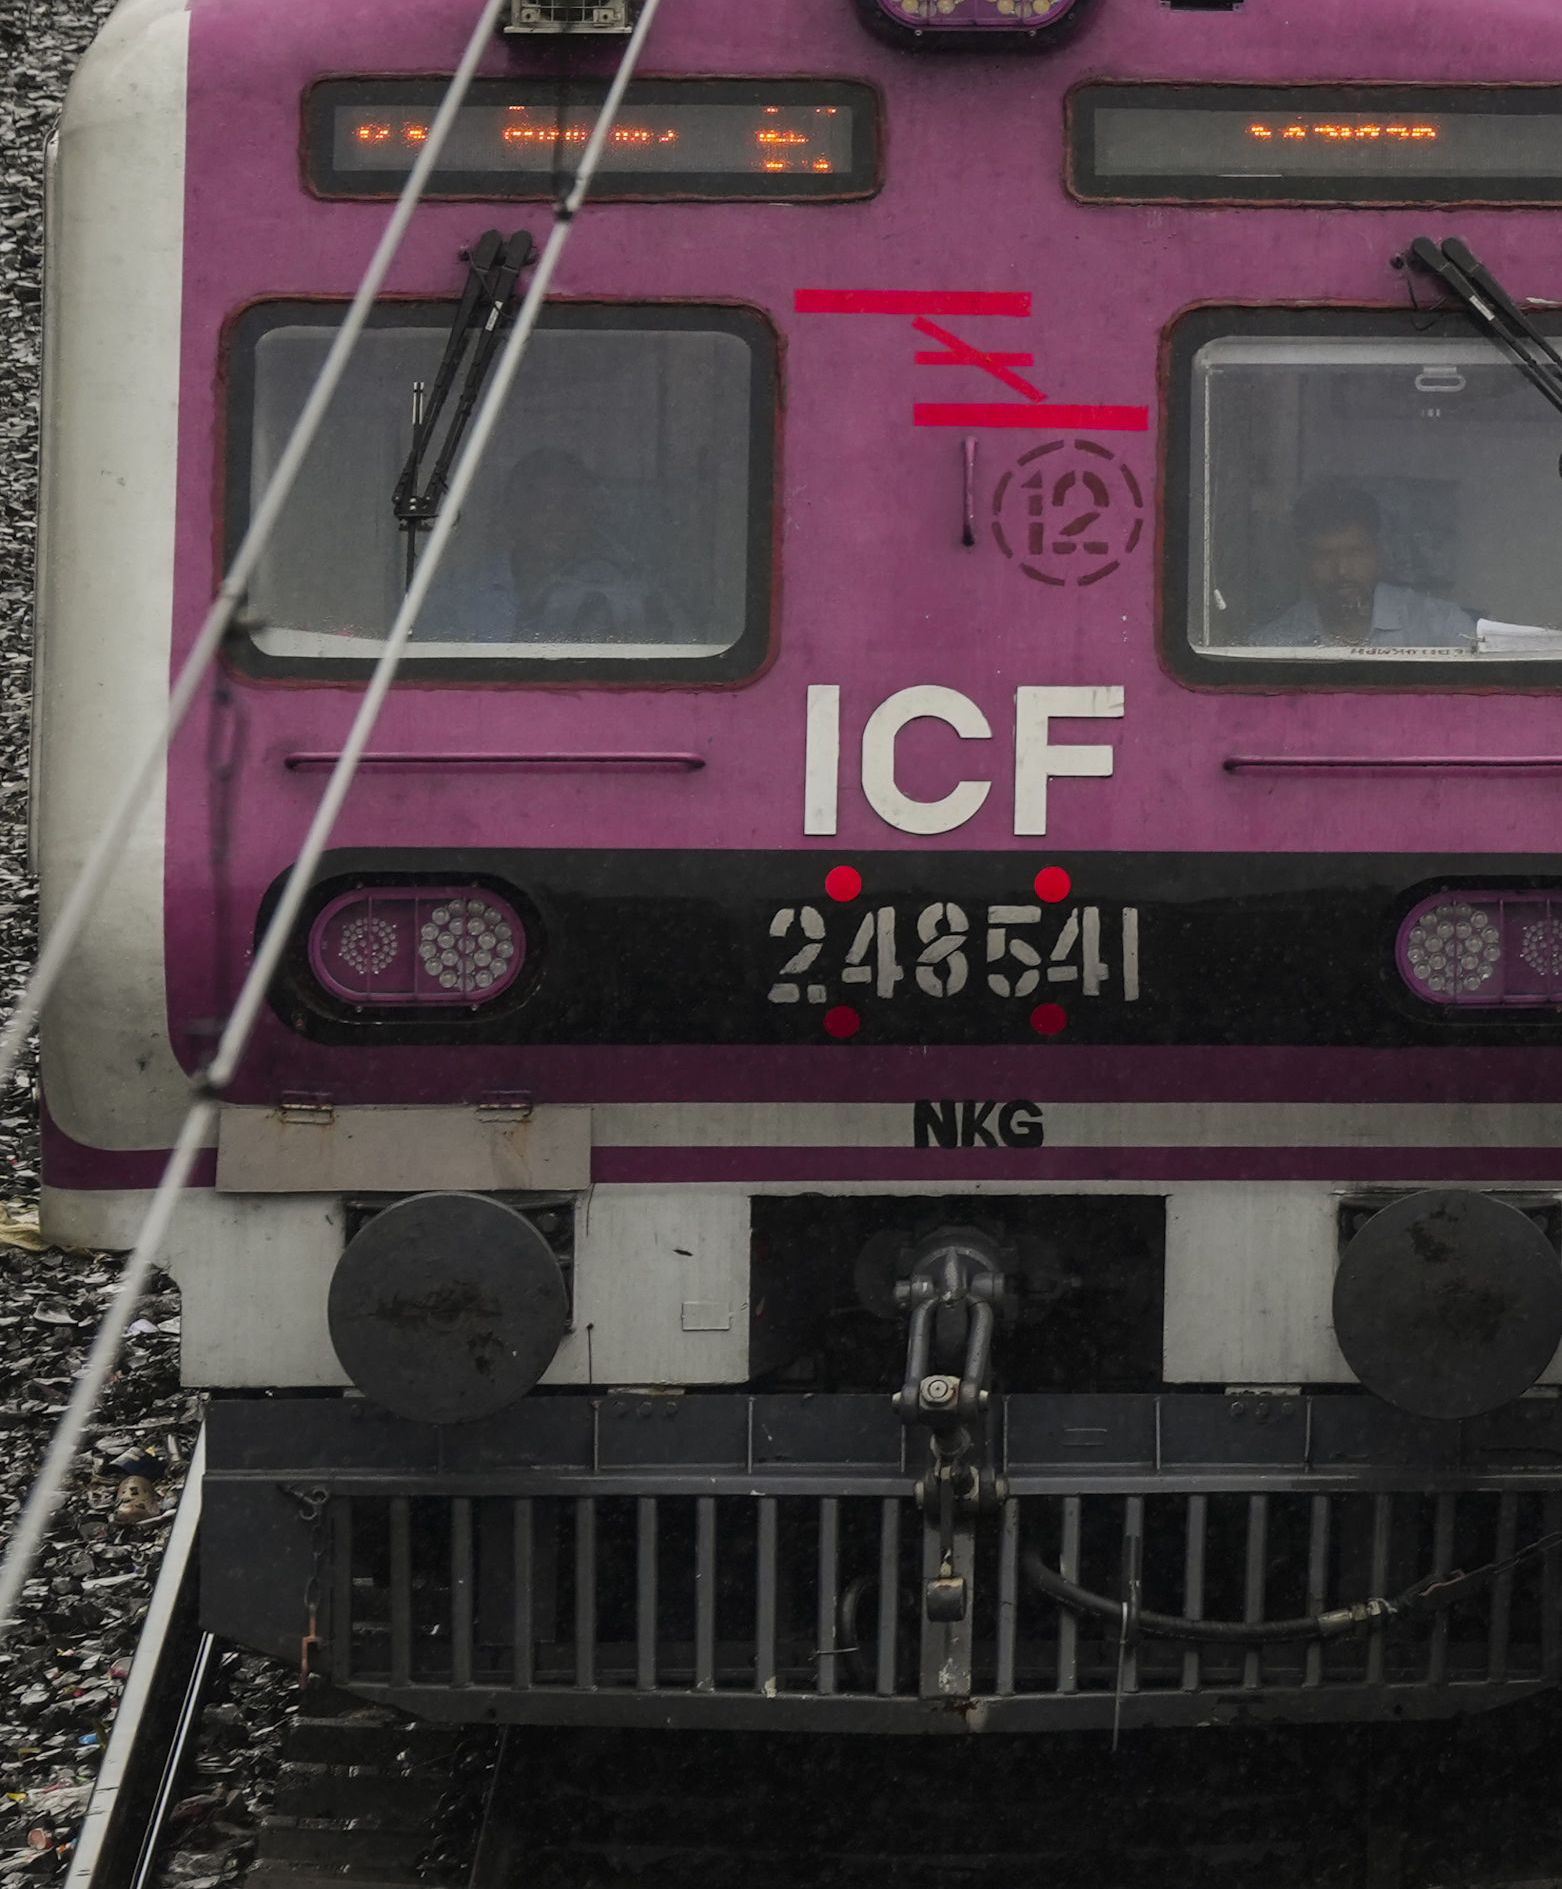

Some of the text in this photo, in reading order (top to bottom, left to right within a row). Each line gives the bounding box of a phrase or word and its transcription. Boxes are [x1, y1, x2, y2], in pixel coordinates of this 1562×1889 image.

[1020, 470, 1110, 555] 12
[803, 684, 1125, 836] ICF
[767, 901, 1140, 1004] 248541
[913, 1098, 1045, 1149] NKG
